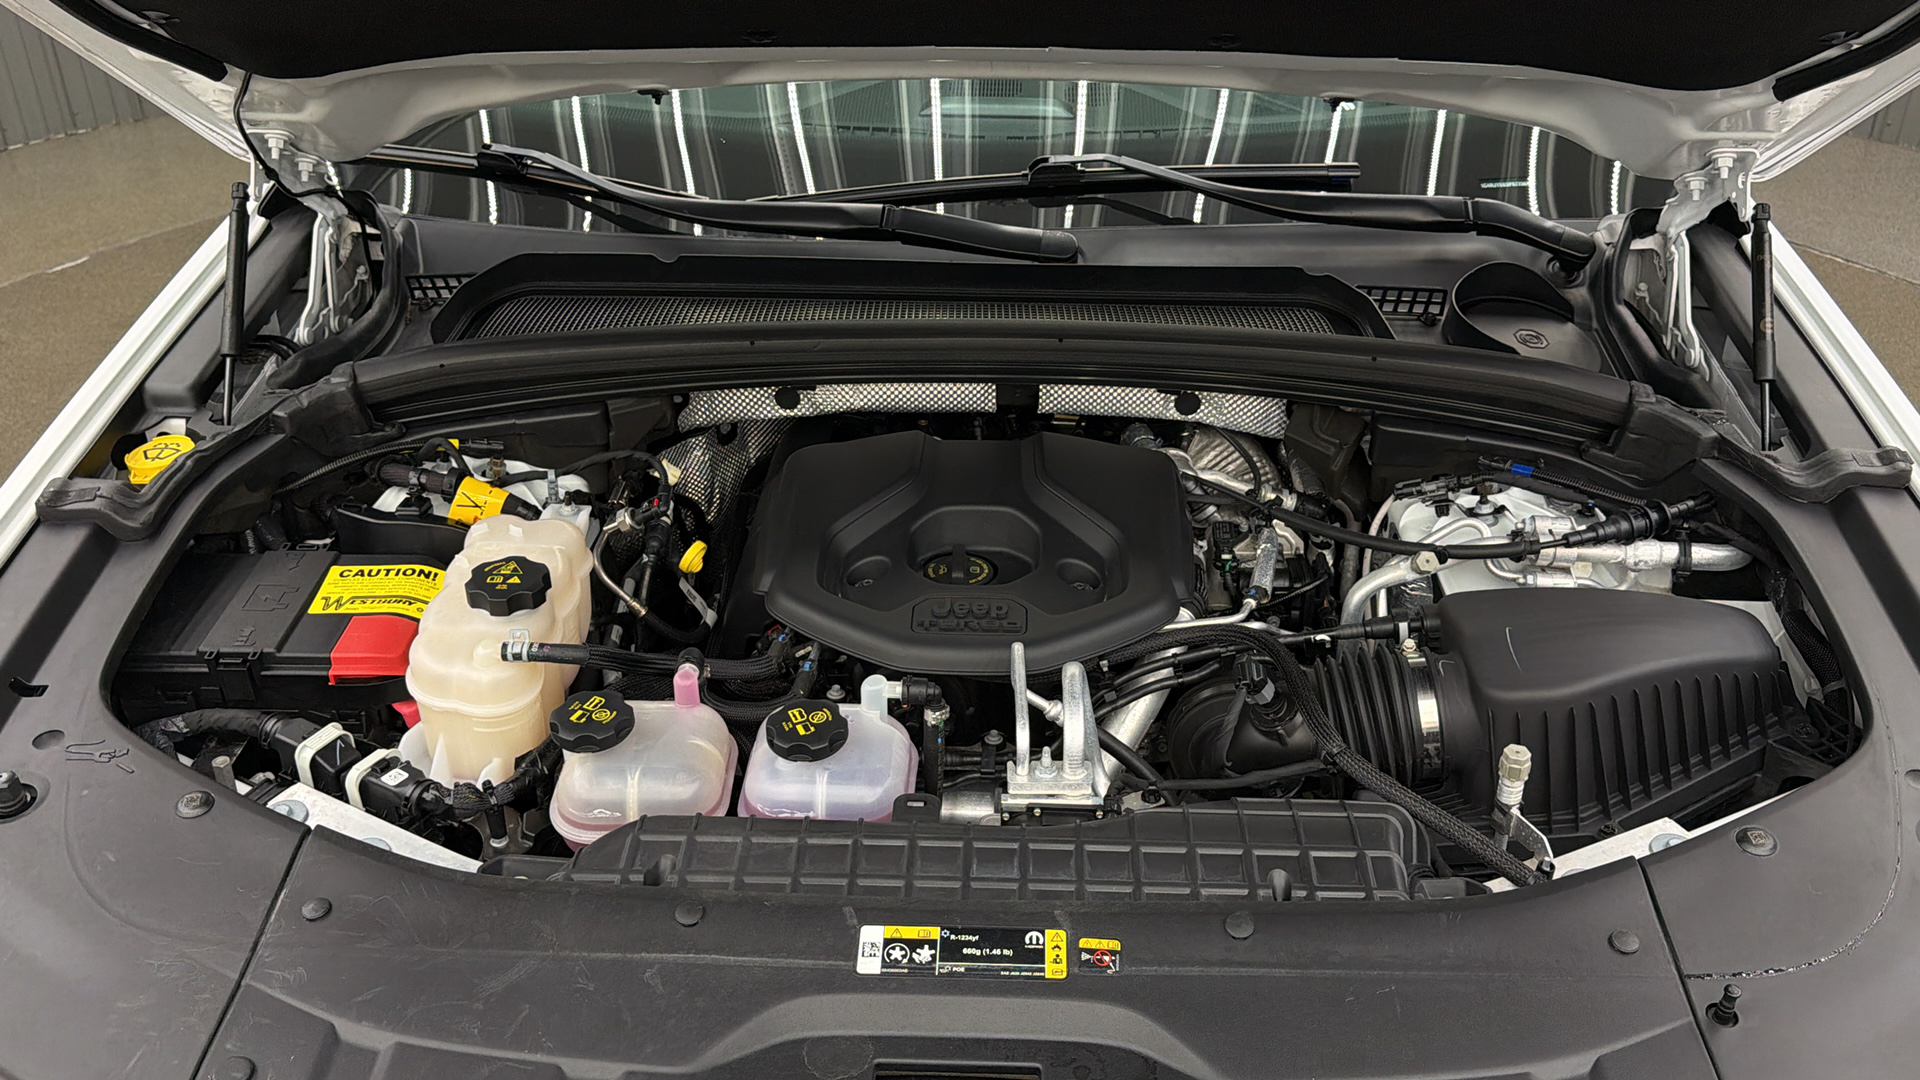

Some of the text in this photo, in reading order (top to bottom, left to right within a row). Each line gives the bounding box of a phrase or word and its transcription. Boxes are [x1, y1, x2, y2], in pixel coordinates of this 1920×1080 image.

[339, 567, 439, 581] CAUTION!
[320, 595, 417, 611] WESTBURY
[931, 597, 1009, 620] Jeep
[950, 934, 979, 942] R-1234yf
[962, 947, 982, 956] 660g
[1002, 948, 1013, 957] lb)
